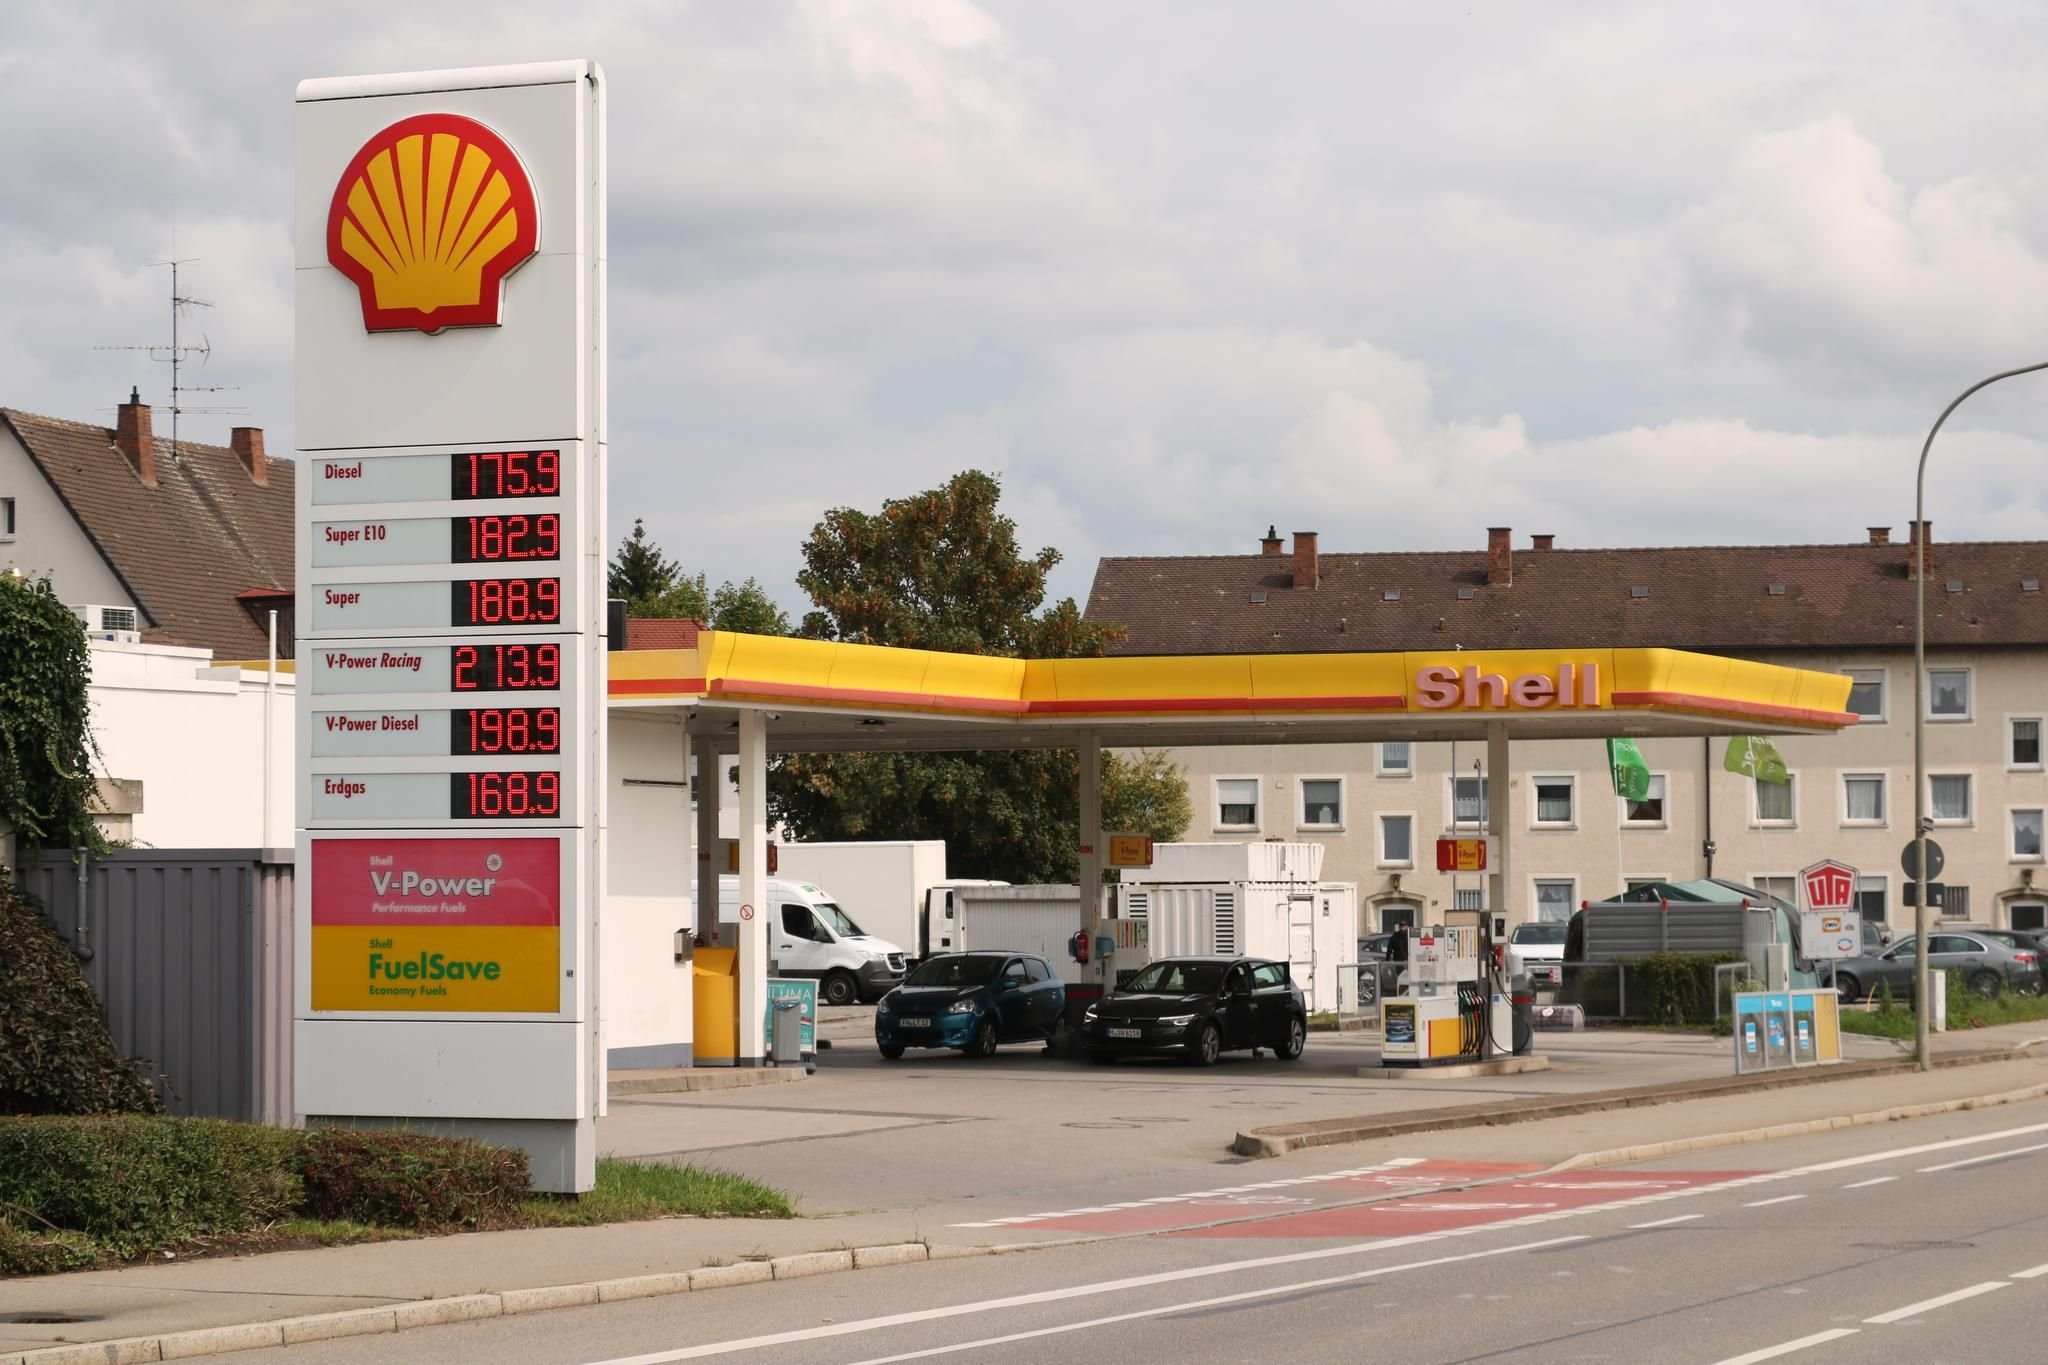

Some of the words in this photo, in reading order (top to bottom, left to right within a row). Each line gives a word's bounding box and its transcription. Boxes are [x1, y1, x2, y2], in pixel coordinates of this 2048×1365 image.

[325, 463, 362, 480] Diesel
[469, 451, 559, 496] 175.9
[325, 528, 360, 546] Super
[364, 525, 386, 541] E10
[469, 515, 559, 559] 182.9
[325, 590, 360, 608] Super
[469, 579, 559, 622] 188.9
[326, 653, 377, 669] V-Power
[380, 652, 422, 672] Racing
[456, 645, 559, 688] 213.9
[1415, 663, 1600, 708] Shell
[326, 717, 377, 731] V-Power
[381, 714, 419, 730] Diesel
[469, 709, 559, 752] 198.9
[325, 778, 366, 798] Erdgas
[469, 772, 559, 815] 168.9
[369, 855, 393, 866] Shell
[369, 870, 496, 897] V-Power
[1806, 866, 1852, 906] UTA
[372, 901, 437, 913] Performance
[440, 901, 466, 913] Fuels
[369, 938, 393, 949] Shell
[369, 951, 501, 981] FuelSave
[369, 984, 416, 997] Economy
[420, 985, 447, 996] Fuels
